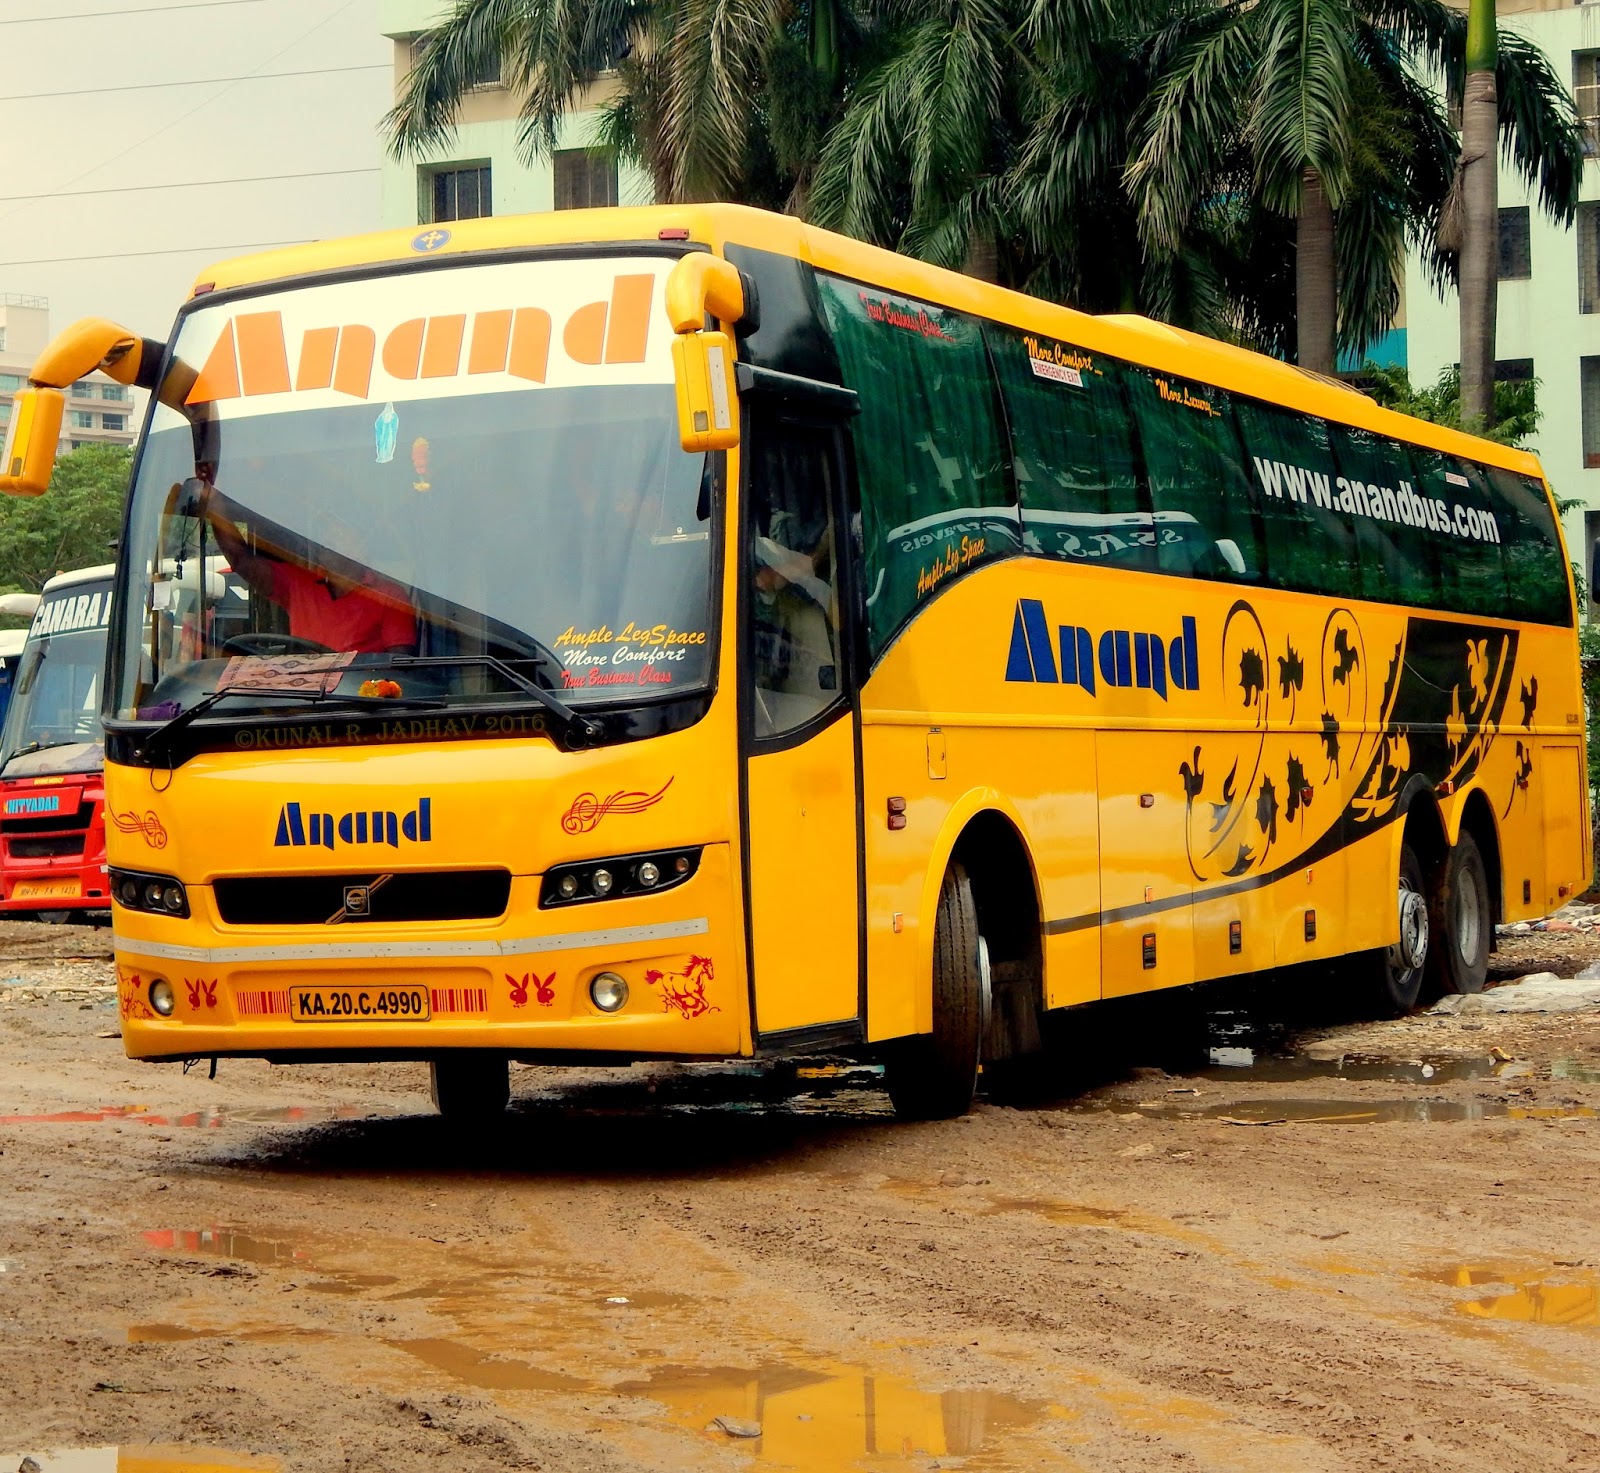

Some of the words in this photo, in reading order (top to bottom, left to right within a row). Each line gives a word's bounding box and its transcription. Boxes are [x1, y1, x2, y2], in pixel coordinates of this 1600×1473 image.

[185, 273, 655, 405] Anand
[1023, 336, 1054, 362] More
[1033, 362, 1066, 381] EMERGENCY
[1155, 378, 1183, 403] More
[1253, 456, 1500, 543] www.anandbus.com
[917, 567, 945, 599] Ample
[961, 535, 985, 566] Space
[31, 592, 101, 637] CANARA
[554, 625, 613, 648] Ample
[563, 649, 607, 666] More
[611, 646, 686, 665] Comfort
[1005, 598, 1200, 702] Anand
[560, 669, 587, 689] True
[588, 667, 635, 686] Business
[637, 663, 672, 686] Class
[274, 797, 431, 851] Anand
[298, 991, 423, 1016] KA.20.C.4990
